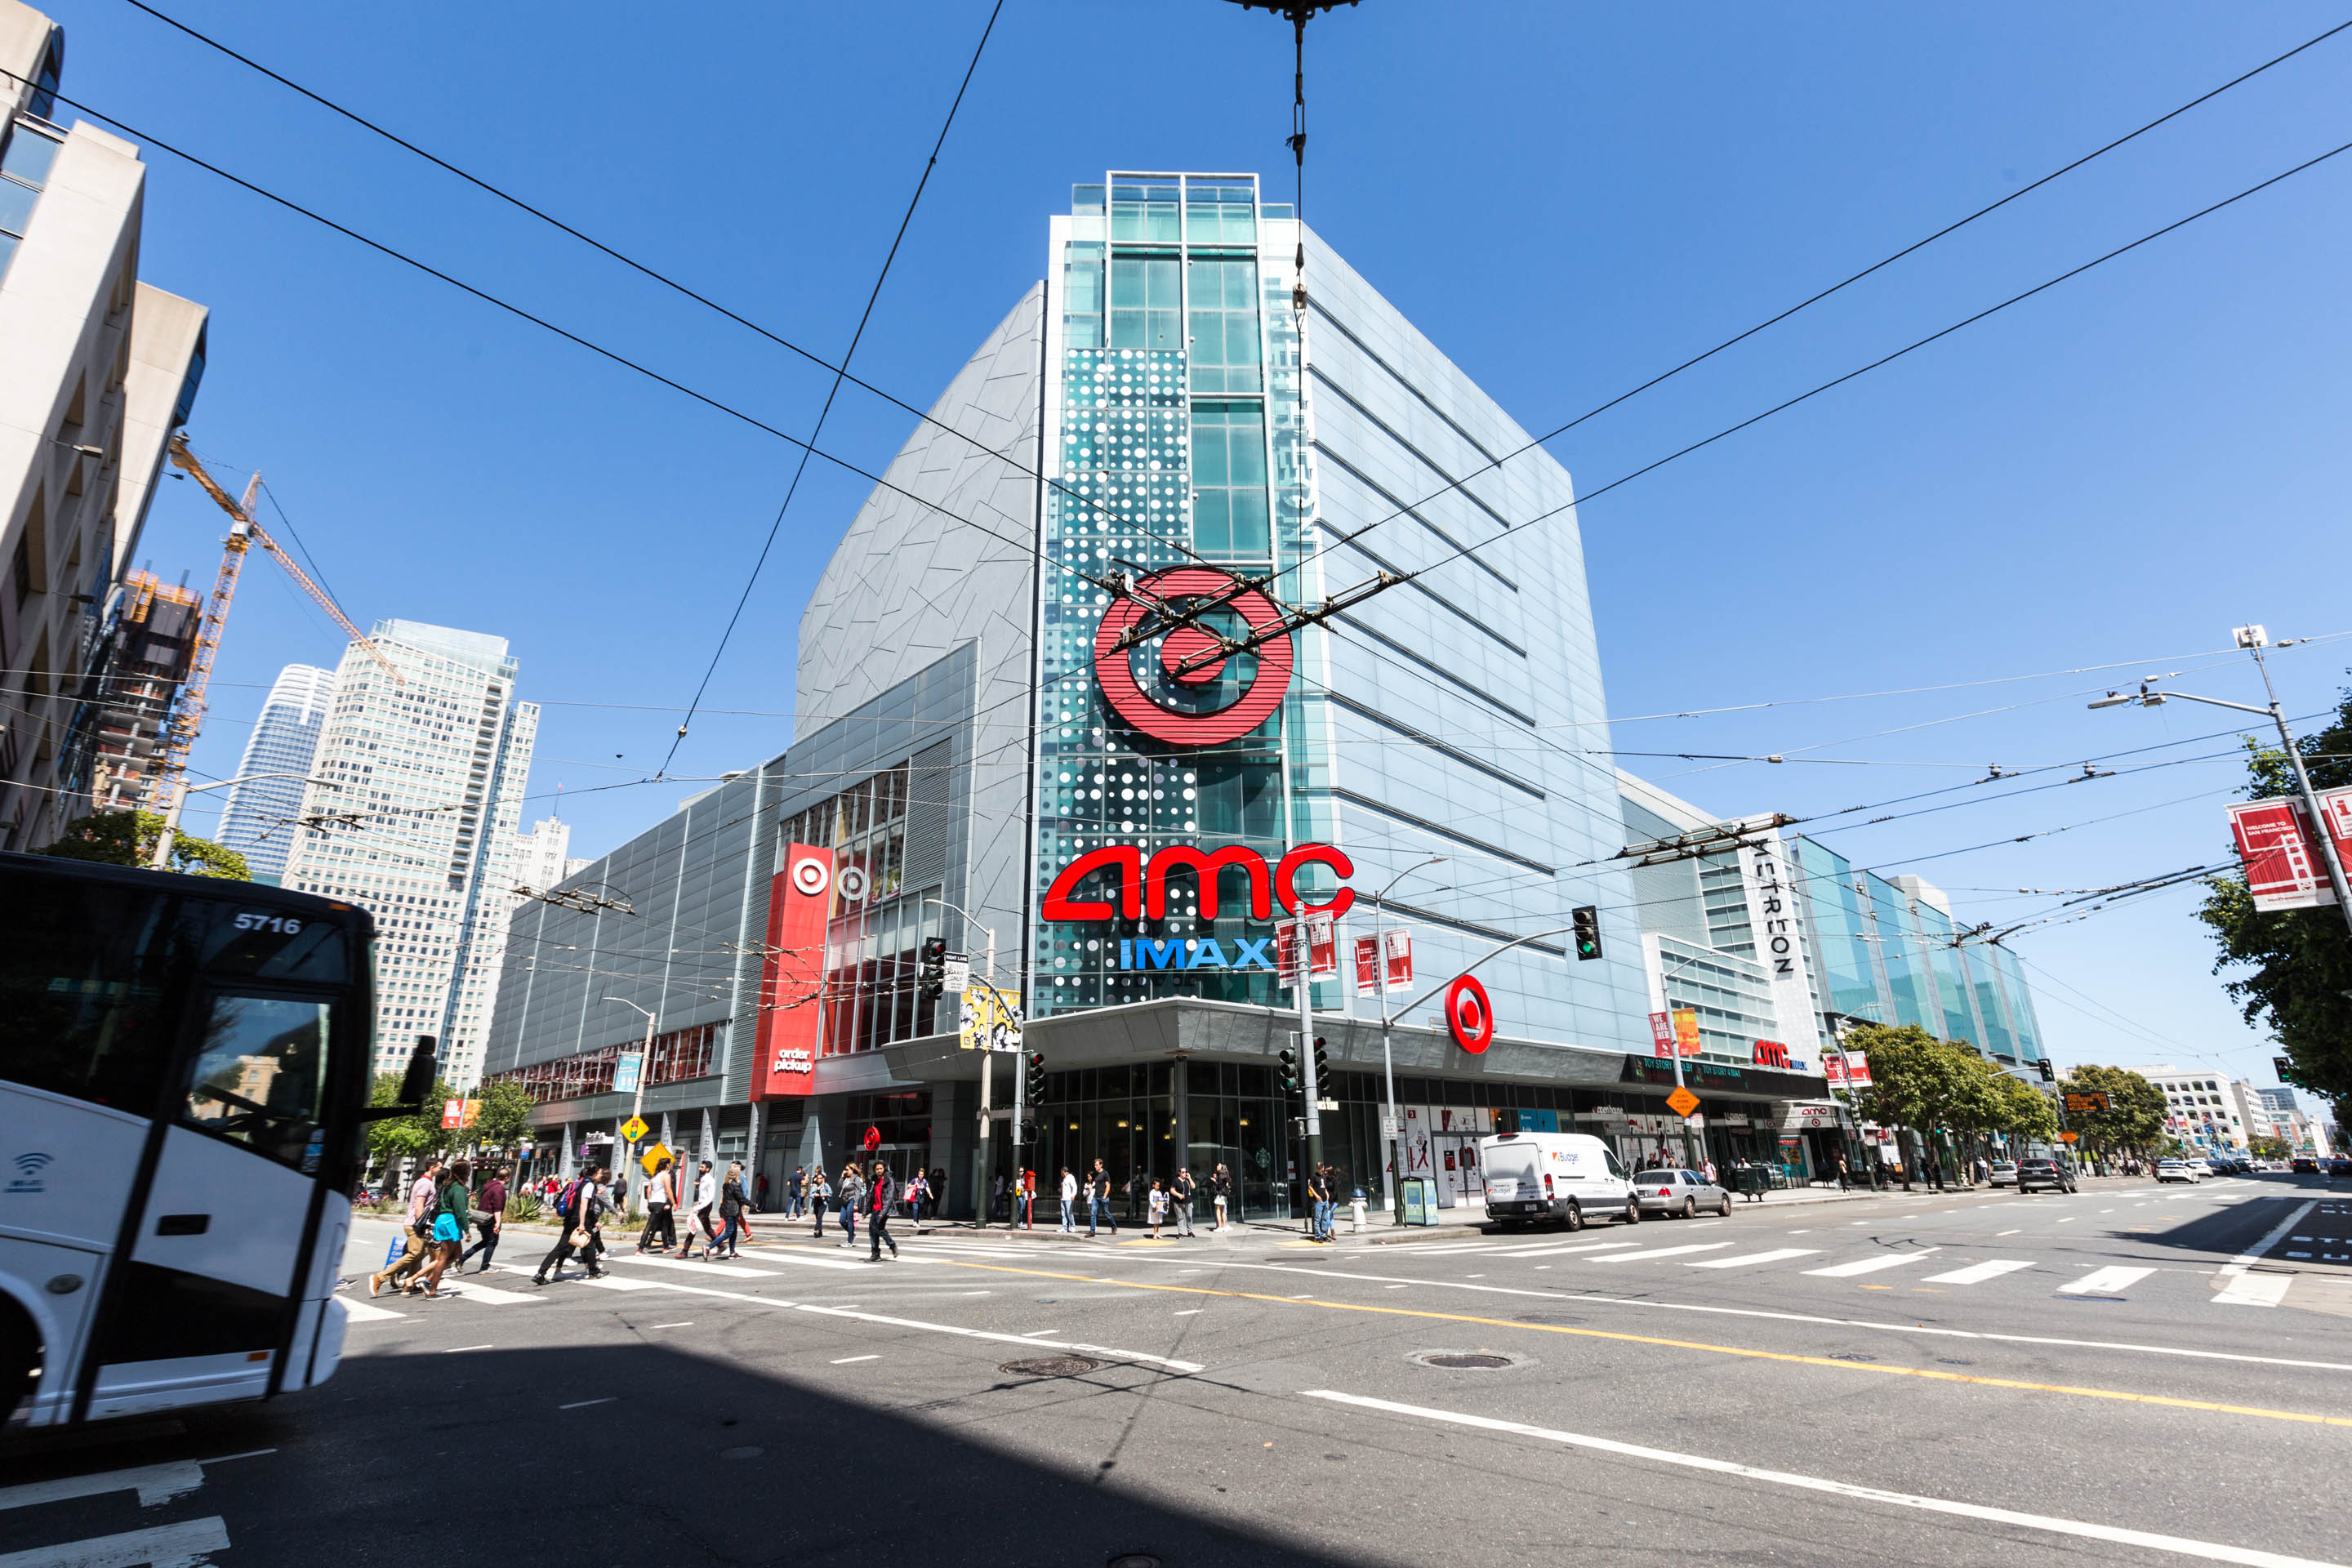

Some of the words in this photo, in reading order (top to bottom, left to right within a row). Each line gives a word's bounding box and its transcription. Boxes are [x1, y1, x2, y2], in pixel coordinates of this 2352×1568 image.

[2261, 826, 2295, 834] FRANCISCO
[1753, 838, 1794, 973] METREON
[233, 912, 301, 934] 5716
[1120, 938, 1274, 969] IMAX
[1653, 1014, 1664, 1022] WE
[1655, 1022, 1668, 1031] ARE
[779, 1048, 810, 1059] order
[774, 1058, 812, 1074] pickup
[1644, 1058, 1655, 1068] TOY
[1655, 1059, 1672, 1070] STORY
[1681, 1061, 1693, 1072] OLBY
[1702, 1064, 1712, 1074] TOY
[1713, 1066, 1726, 1076] STORY
[1560, 1152, 1579, 1165] Budget
